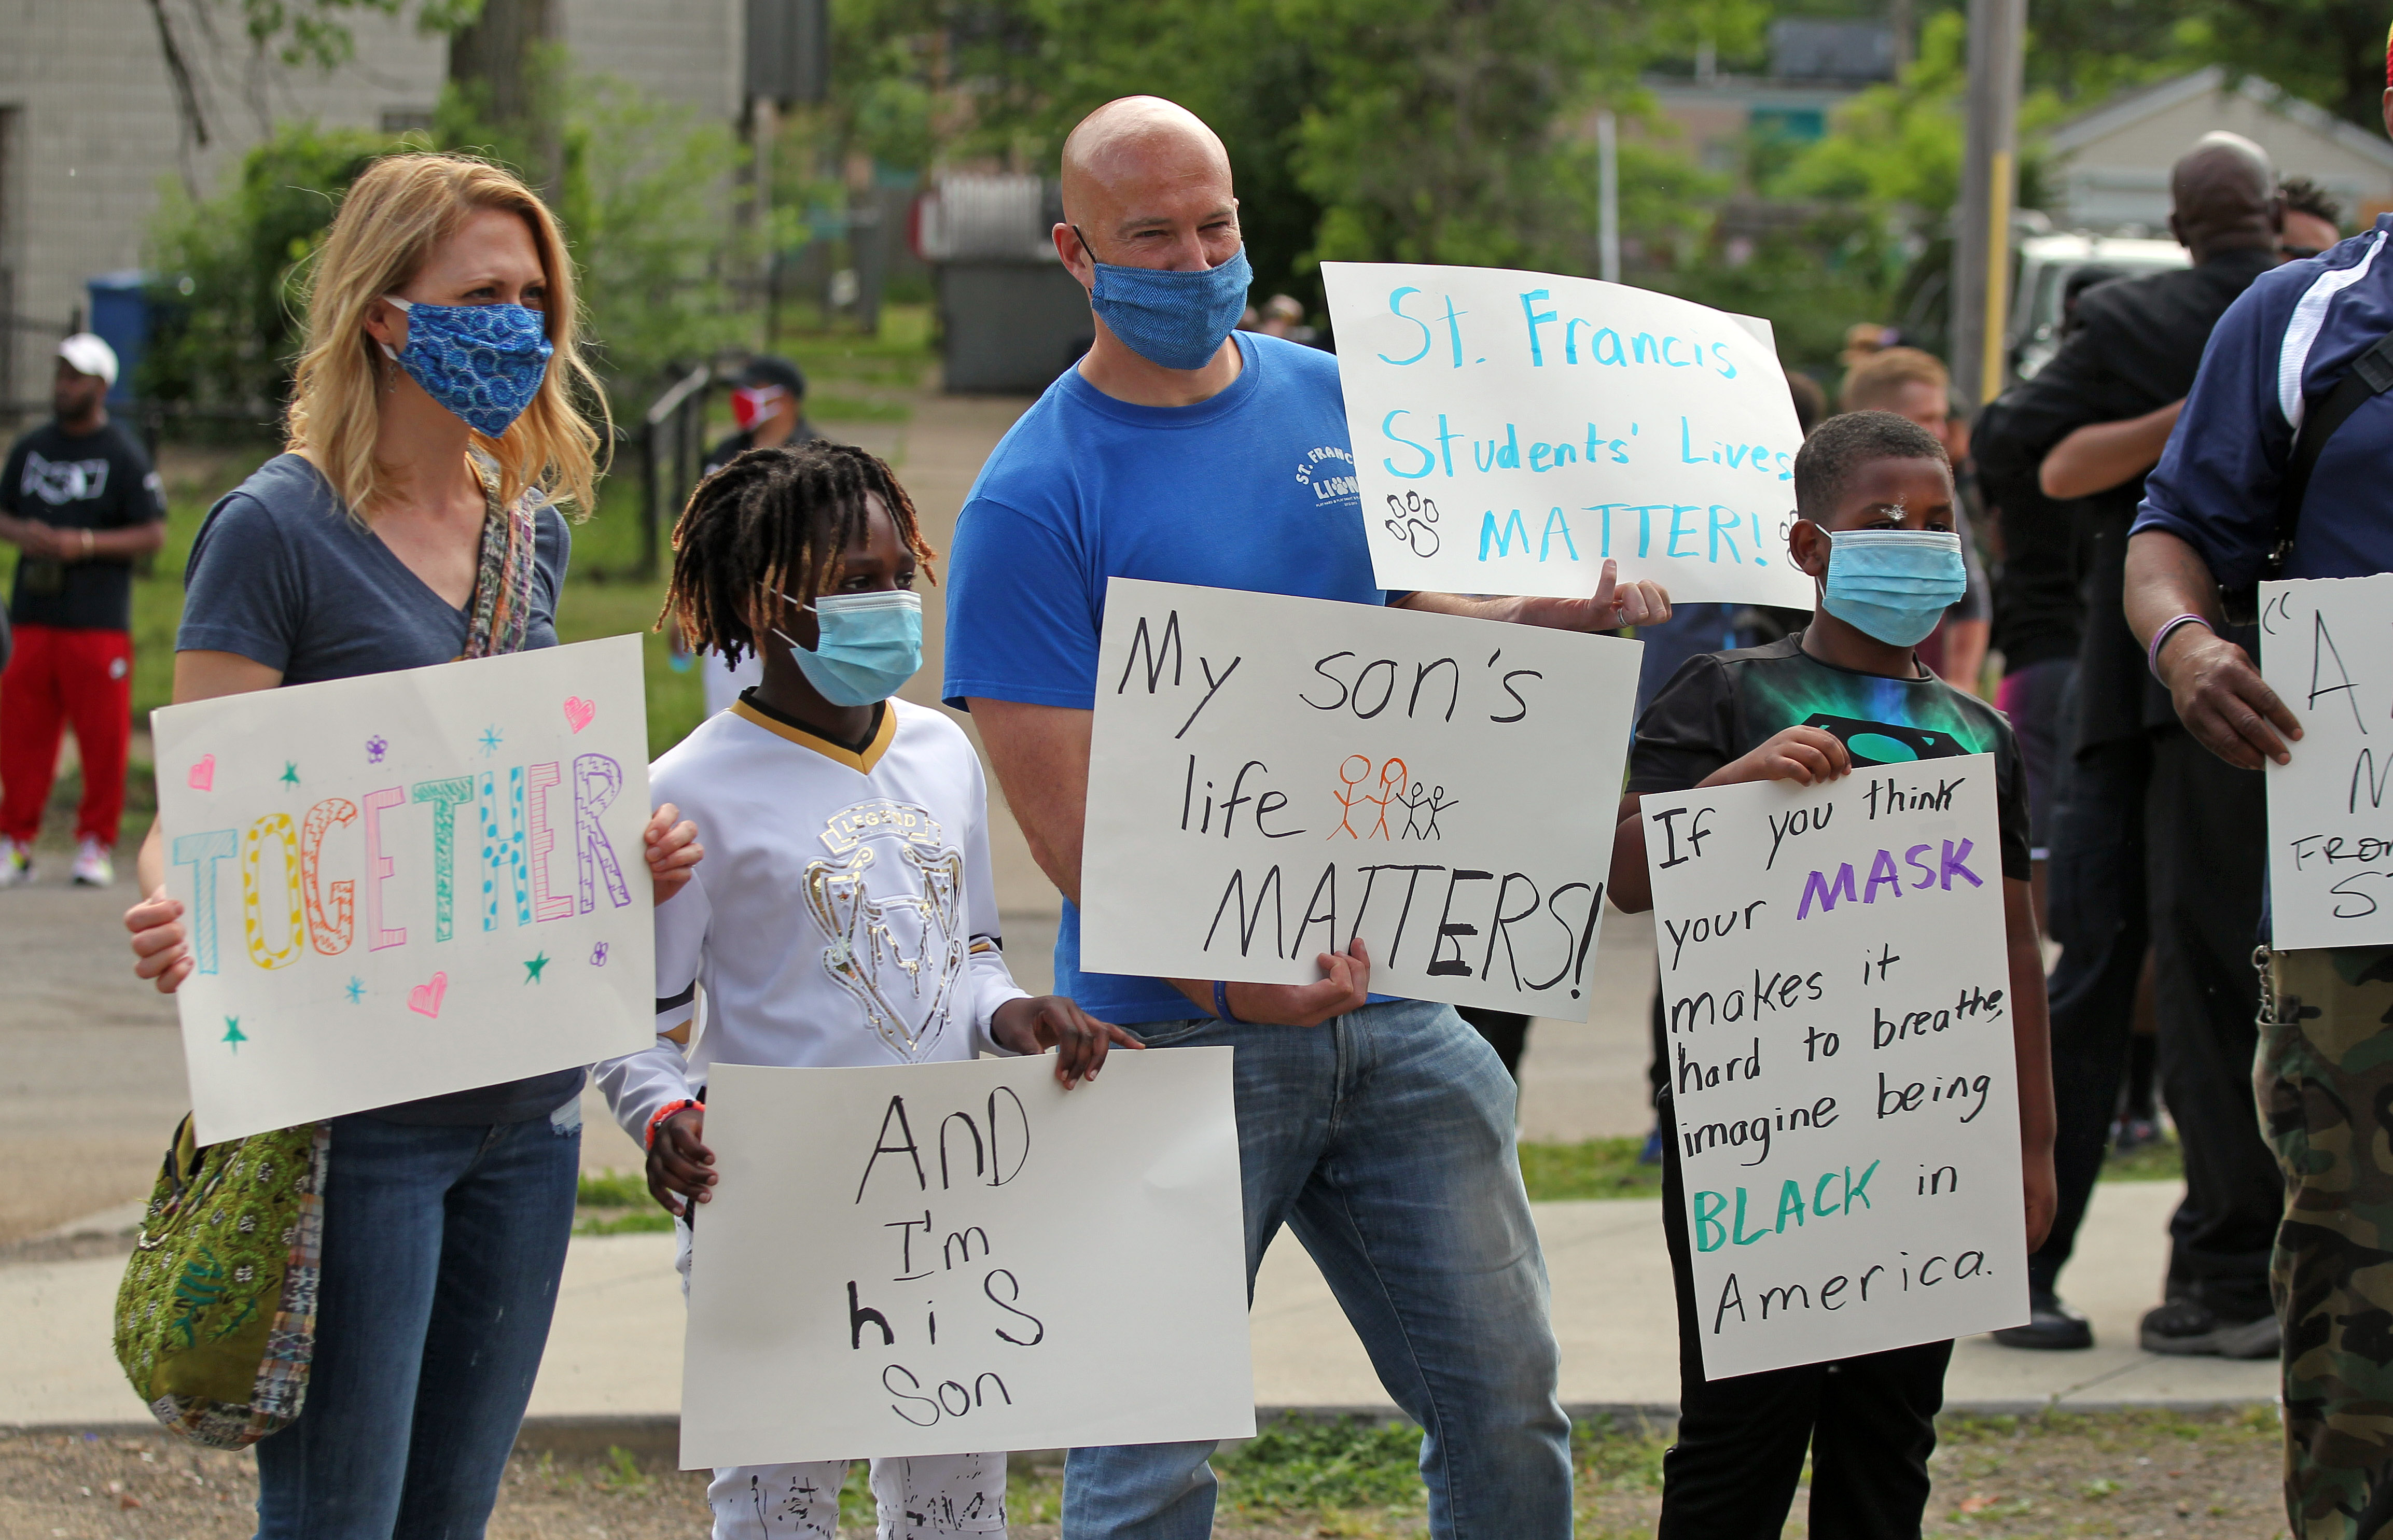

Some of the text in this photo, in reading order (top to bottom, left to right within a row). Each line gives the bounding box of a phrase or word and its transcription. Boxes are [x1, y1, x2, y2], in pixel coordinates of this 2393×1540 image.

[1378, 287, 1737, 379] St. Francis
[1296, 446, 1355, 485] ST. FRANC
[1382, 410, 1793, 481] Students' Lives
[1478, 503, 1768, 567] MATTER!
[1118, 610, 1542, 739] My son's
[841, 810, 917, 833] LEGEND
[1181, 755, 1306, 838] life
[1653, 778, 1966, 870] If you think
[173, 753, 631, 975] TOGETHER
[1665, 838, 1984, 970] your MASK
[1204, 863, 1603, 999] MATTERS!
[1672, 944, 1900, 1033] makes it
[1678, 987, 2004, 1095] hard to breathe,
[1682, 1073, 1991, 1166] imagine being
[885, 1210, 989, 1282] I'm
[1694, 1160, 1957, 1252] BLACK in
[1714, 1251, 1992, 1335] America.
[883, 1365, 1011, 1426] Son
